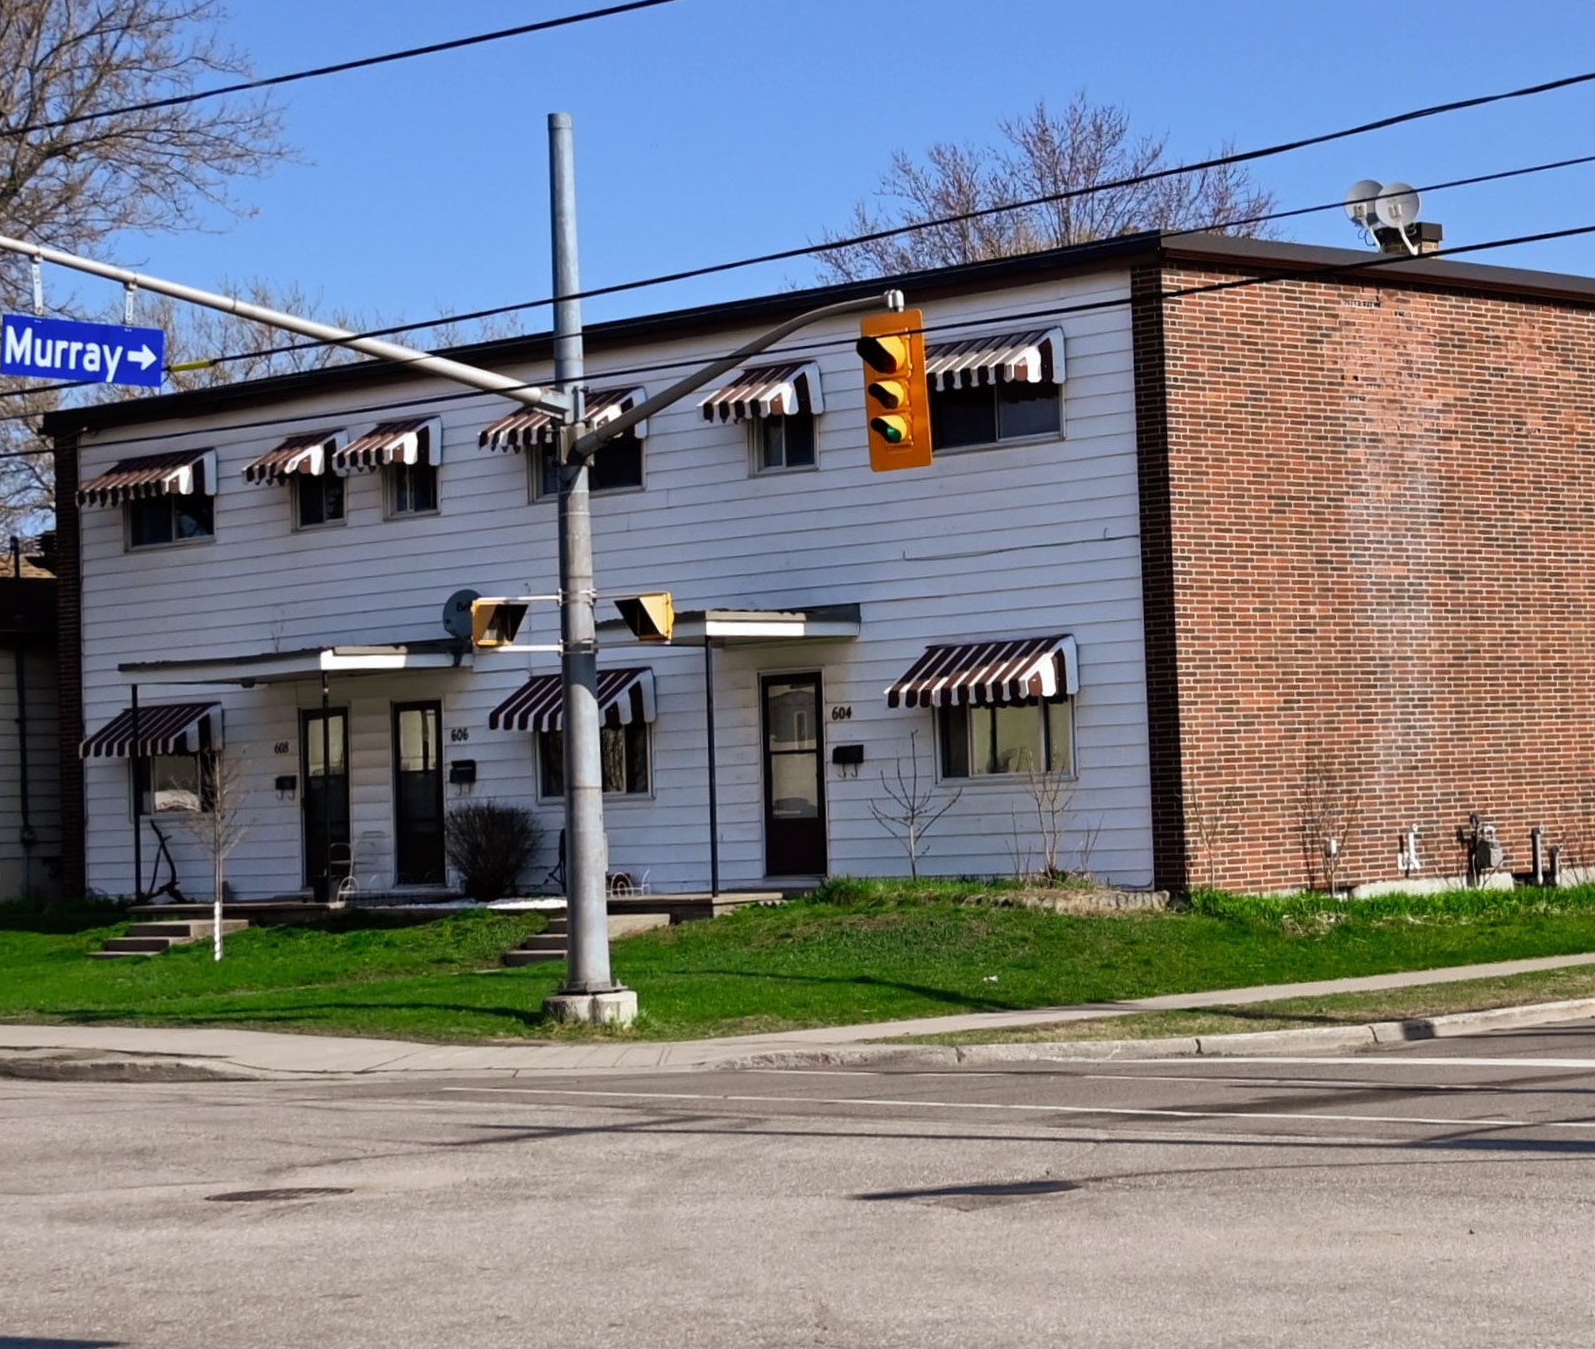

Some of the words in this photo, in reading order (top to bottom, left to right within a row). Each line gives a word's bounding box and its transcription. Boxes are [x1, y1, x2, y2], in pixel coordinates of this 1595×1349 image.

[5, 325, 124, 383] Murray
[831, 705, 853, 721] 604
[451, 728, 469, 742] 606
